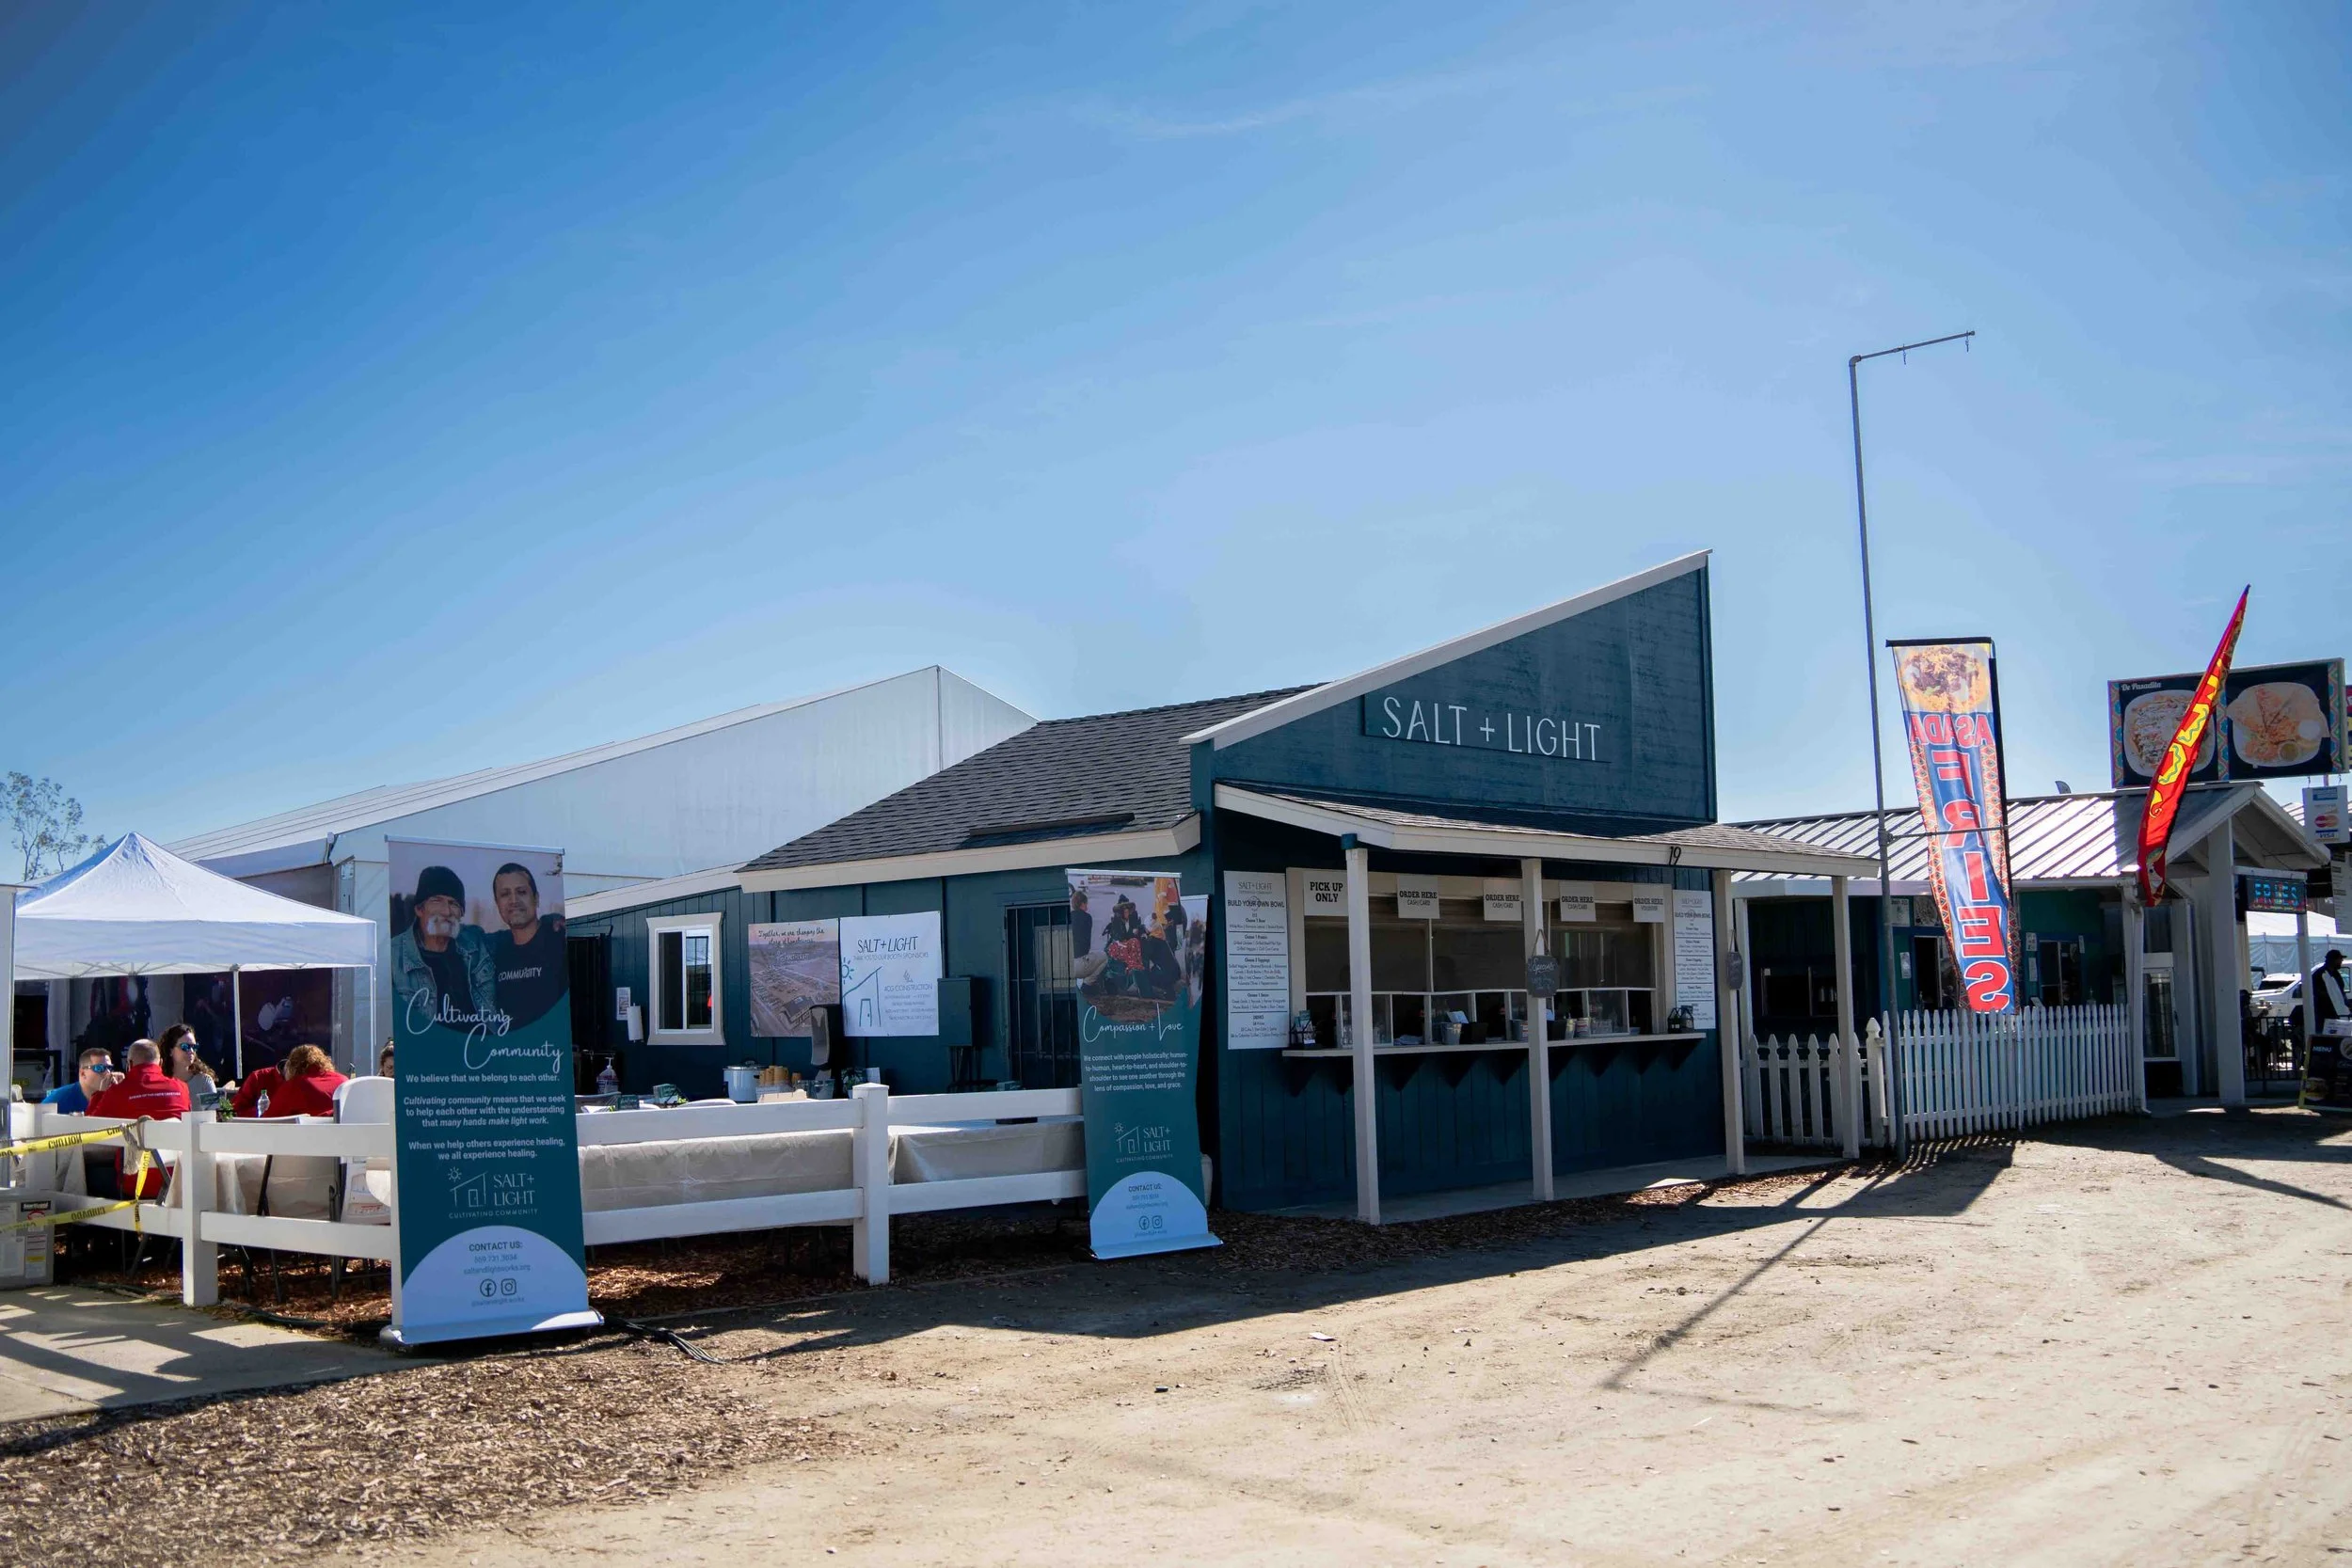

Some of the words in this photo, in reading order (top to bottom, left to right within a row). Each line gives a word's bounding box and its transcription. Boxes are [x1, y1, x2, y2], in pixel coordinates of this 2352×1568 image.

[1382, 696, 1468, 745] SALT
[1480, 718, 1495, 741] +
[1507, 713, 1600, 761] LIGHT
[1668, 846, 1682, 865] 19
[1310, 881, 1330, 892] PICK
[1332, 882, 1343, 892] UP
[1315, 894, 1339, 903] ONLY
[1399, 890, 1420, 899] ORDER
[1421, 891, 1438, 899] HERE
[1485, 894, 1503, 902] ORDER
[1504, 894, 1520, 902] HERE
[1242, 899, 1257, 908] YOUR
[405, 988, 514, 1037] Cultivating
[1083, 1006, 1146, 1043] Compassion
[1149, 1022, 1155, 1031] +
[1156, 1002, 1184, 1041] Love
[464, 1022, 564, 1074] Community
[405, 1074, 419, 1083] We
[421, 1074, 450, 1083] believe
[481, 1074, 508, 1084] belong
[518, 1073, 536, 1082] each
[537, 1073, 560, 1082] other.
[1113, 1084, 1144, 1092] compassion,
[403, 1096, 446, 1106] Cultivating
[447, 1097, 491, 1106] community
[518, 1095, 534, 1103] that
[548, 1094, 566, 1102] seek
[405, 1108, 415, 1117] to
[416, 1108, 434, 1117] help
[436, 1107, 455, 1116] each
[456, 1107, 478, 1116] other
[479, 1106, 496, 1115] with
[497, 1106, 510, 1115] the
[511, 1105, 565, 1115] understanding
[439, 1119, 461, 1129] many
[463, 1117, 486, 1126] hands
[488, 1117, 510, 1126] make
[510, 1117, 527, 1127] light
[529, 1116, 549, 1124] work.
[408, 1141, 432, 1150] When
[447, 1140, 465, 1150] help
[466, 1139, 492, 1148] others
[493, 1138, 534, 1148] experience
[535, 1137, 565, 1148] healing,
[1143, 1139, 1171, 1153] LIGHT
[452, 1151, 462, 1160] all
[463, 1150, 506, 1161] experience
[507, 1149, 537, 1159] healing.
[494, 1190, 535, 1206] LIGHT
[448, 1210, 494, 1219] CULTIVATING
[495, 1208, 538, 1216] COMMUNITY
[469, 1242, 508, 1252] CONTACT
[509, 1241, 523, 1249] US:
